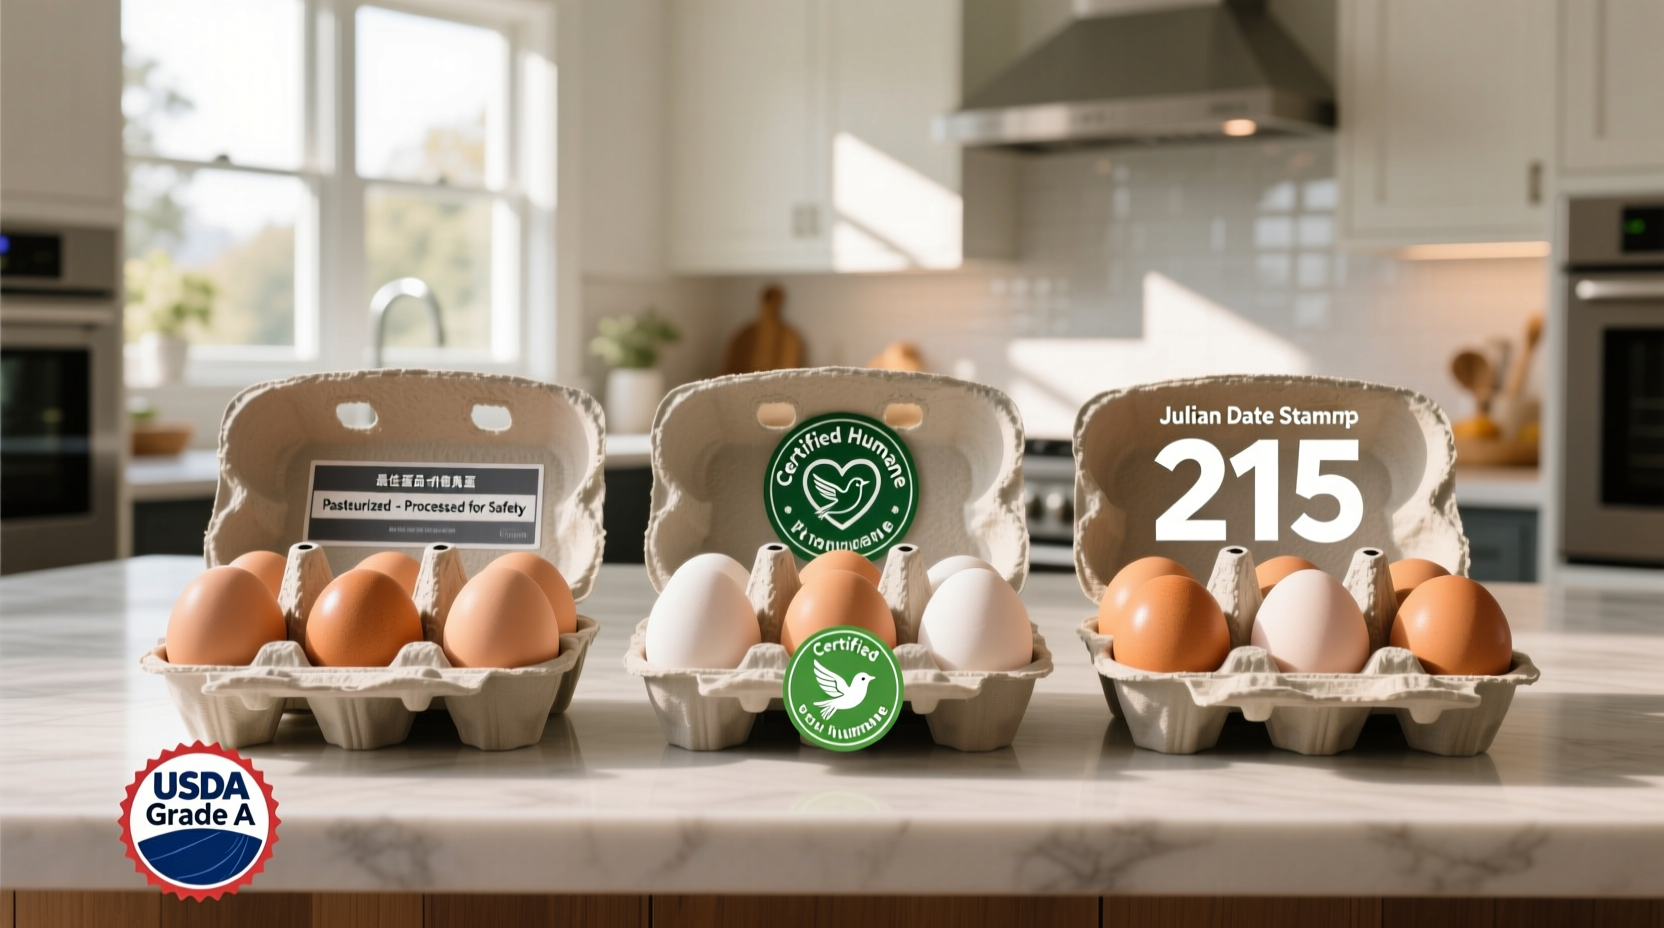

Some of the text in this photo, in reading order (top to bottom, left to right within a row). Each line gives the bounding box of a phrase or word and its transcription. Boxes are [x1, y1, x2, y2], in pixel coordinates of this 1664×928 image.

[776, 426, 906, 489] Certified Humane
[322, 498, 392, 512] Pasteurized
[404, 500, 465, 513] Processed
[468, 500, 486, 514] for
[488, 501, 527, 517] Safety
[813, 636, 879, 662] Certified
